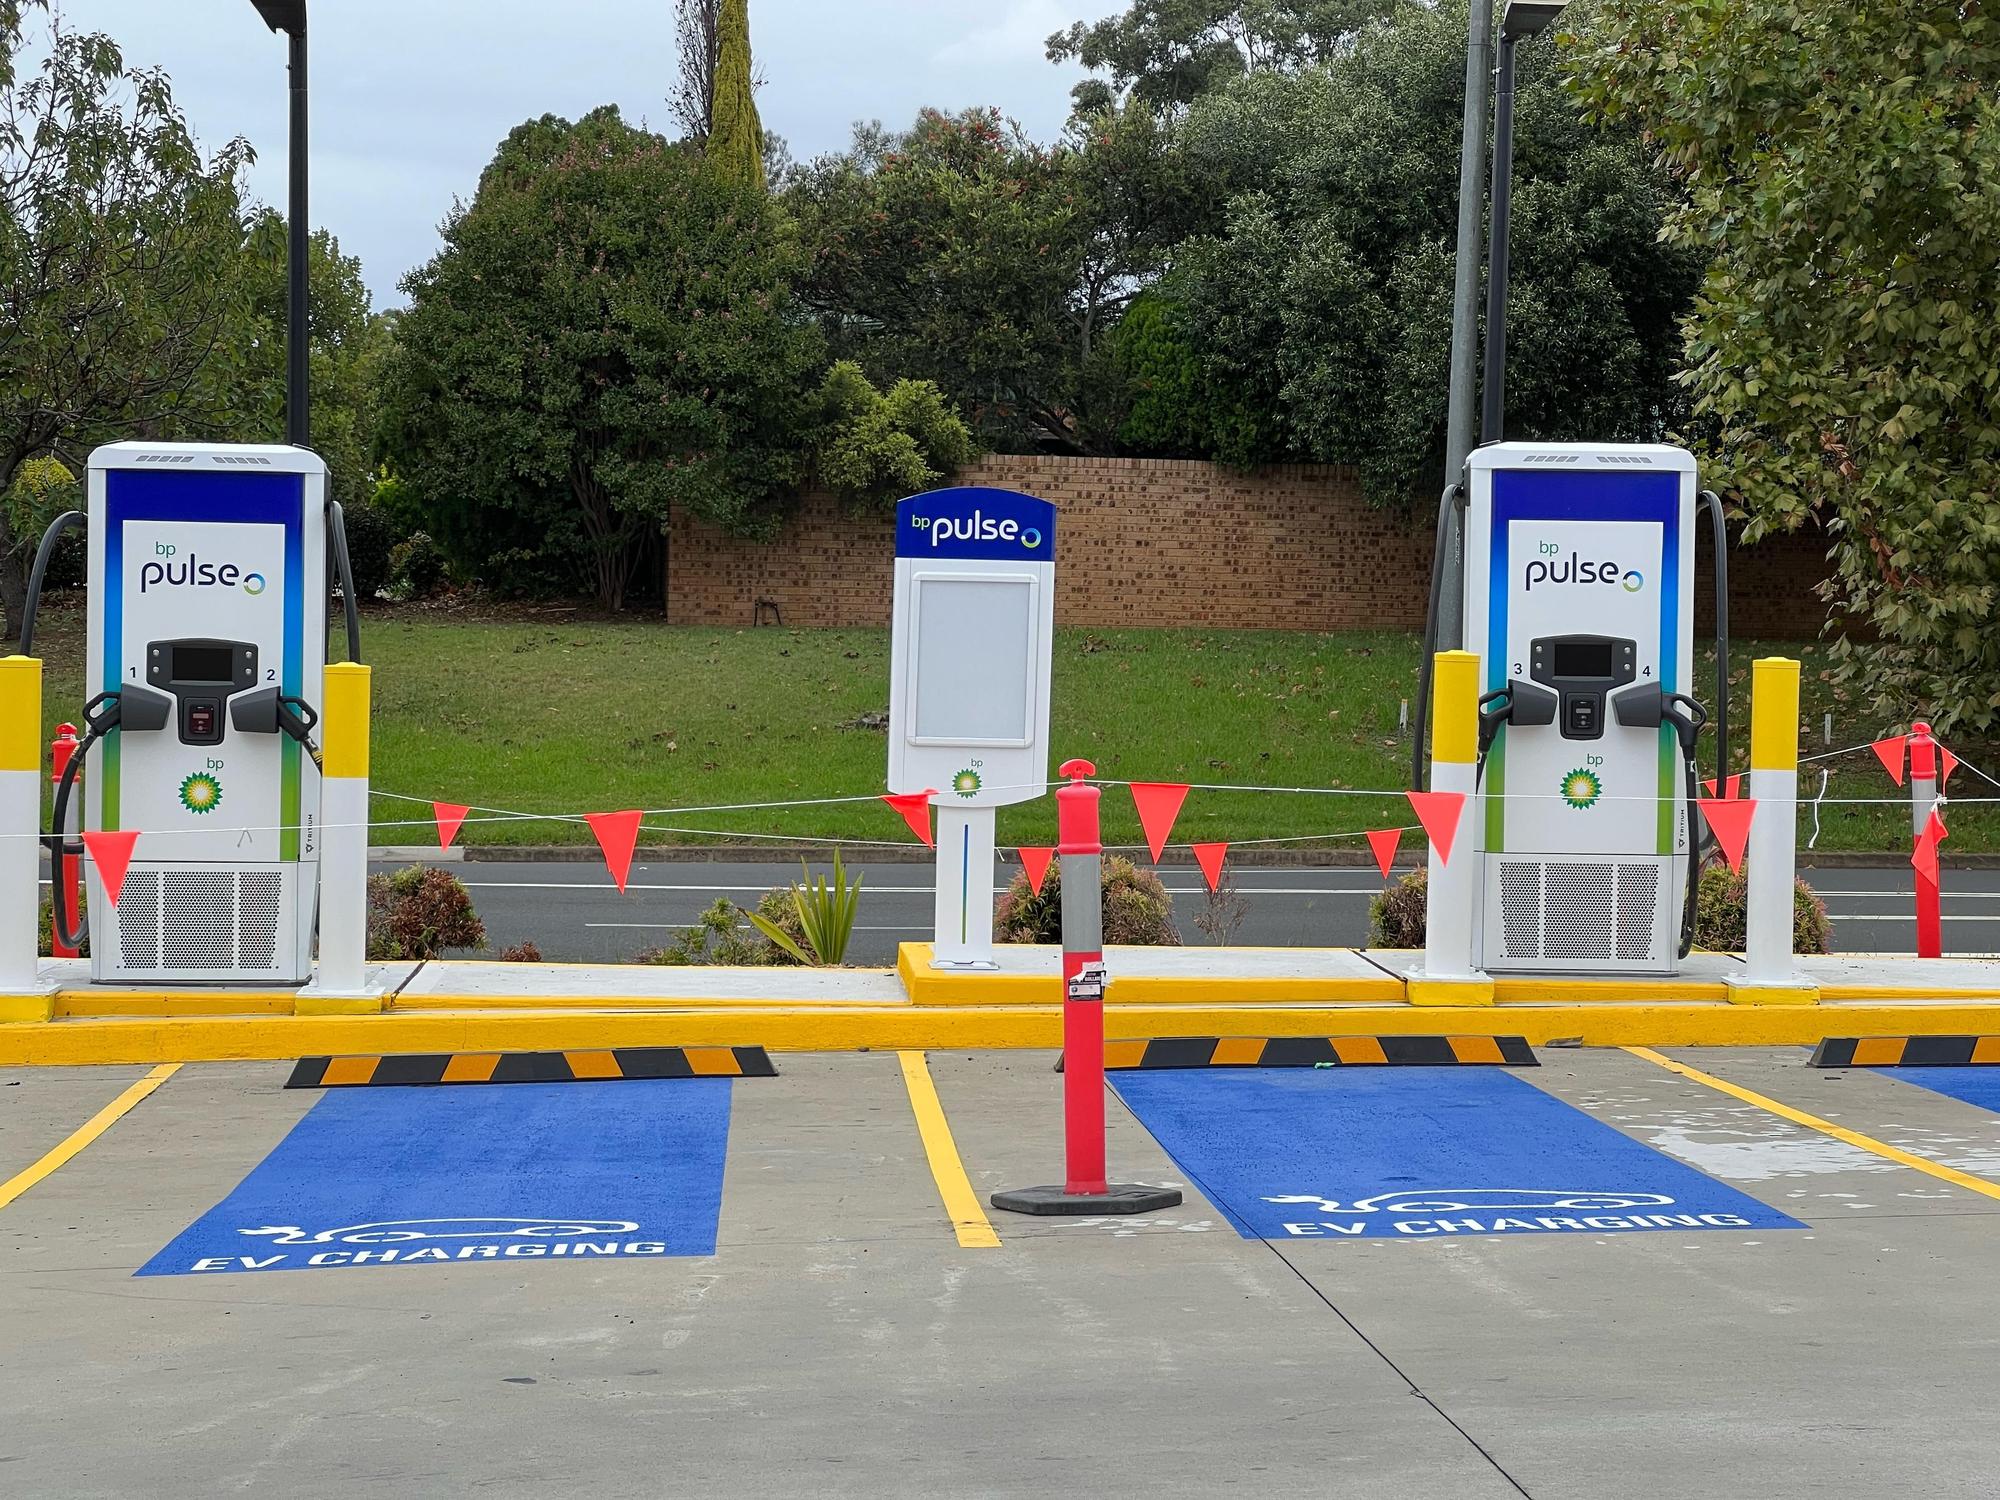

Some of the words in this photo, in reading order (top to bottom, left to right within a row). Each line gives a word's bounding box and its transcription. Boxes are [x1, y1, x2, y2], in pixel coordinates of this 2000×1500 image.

[912, 514, 930, 529] bp
[932, 510, 1019, 546] pulse
[155, 541, 176, 558] bp
[1539, 540, 1559, 557] bp
[141, 553, 239, 593] pulse
[1525, 551, 1619, 591] pulse
[129, 666, 137, 678] 1
[266, 669, 275, 681] 2
[1513, 663, 1523, 675] 3
[1642, 665, 1651, 677] 4
[206, 757, 224, 771] bp
[970, 758, 983, 769] bp
[1586, 753, 1604, 766] bp
[1282, 1222, 1367, 1236] EV
[1394, 1213, 1752, 1236] CHARGING
[190, 1255, 288, 1271] EV
[307, 1242, 666, 1266] CHARGING
